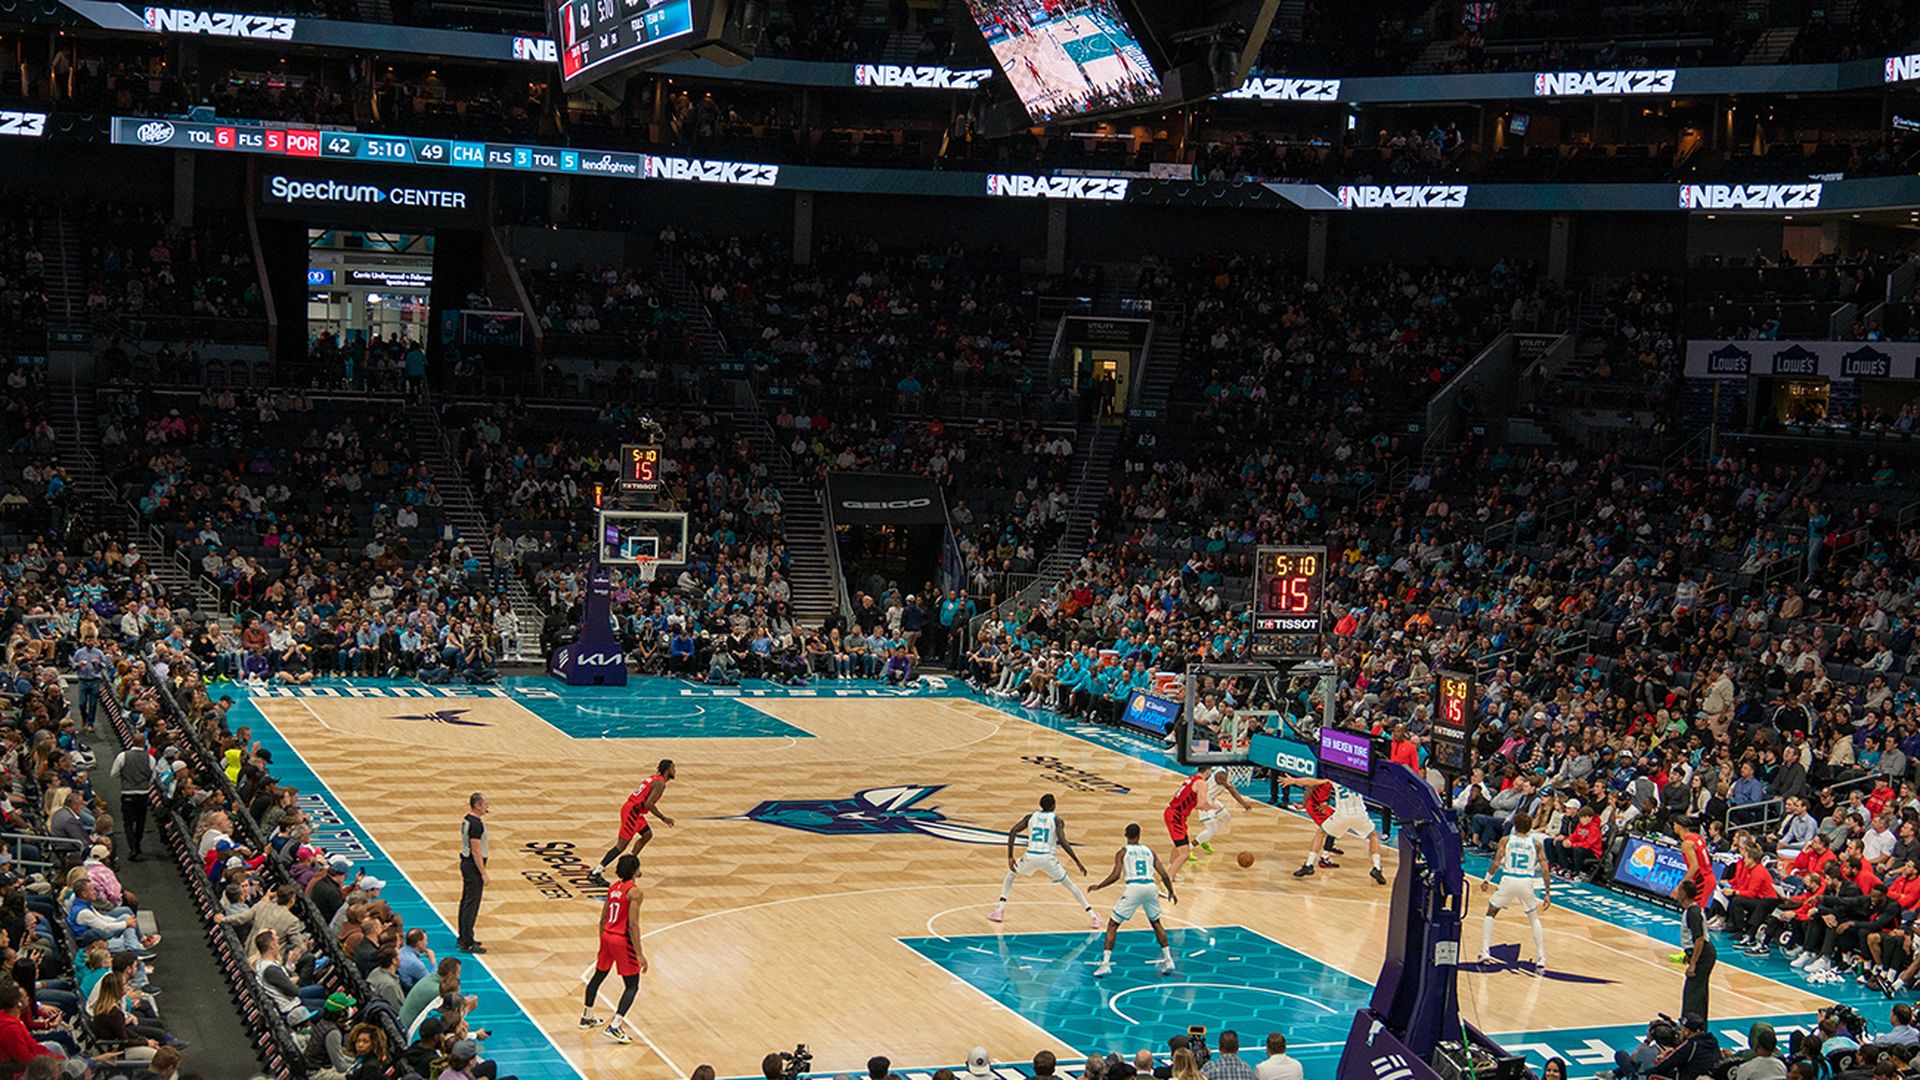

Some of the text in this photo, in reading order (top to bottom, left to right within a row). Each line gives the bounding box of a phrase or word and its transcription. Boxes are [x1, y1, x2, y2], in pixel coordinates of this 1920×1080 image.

[154, 8, 296, 40] NBA2K23
[1222, 78, 1341, 101] A2K23
[1544, 70, 1676, 96] NBA2K23
[188, 130, 229, 144] TOL 6
[238, 134, 278, 148] FLS 5
[286, 135, 318, 151] POR
[328, 138, 350, 153] 42
[367, 141, 406, 158] 5:10
[421, 145, 443, 160] 49
[453, 145, 484, 162] CHA
[489, 151, 527, 164] FLS 3
[533, 154, 575, 168] TOL 5
[650, 156, 780, 186] NBA2K23
[271, 176, 466, 208] Spectrum CENTER
[997, 174, 1128, 200] NBA2K23
[1345, 185, 1468, 209] NBA2K23
[1689, 184, 1821, 209] NBA2K23
[1712, 355, 1748, 372] LOWE'S
[1776, 356, 1814, 373] LOWE'S
[1845, 357, 1887, 375] LOWE'S
[633, 449, 657, 461] 5:10
[635, 462, 653, 481] 15
[633, 482, 659, 491] TISSOT
[842, 498, 931, 510] GEICO
[1276, 555, 1316, 576] 5:10
[1279, 577, 1310, 613] 15
[1275, 618, 1319, 631] TISSOT
[249, 686, 560, 699] HORNETS
[1449, 698, 1461, 721] 15
[1276, 752, 1314, 776] GEICO
[1031, 827, 1049, 843] 21
[1135, 860, 1147, 877] 9
[1511, 852, 1530, 869] 12
[608, 902, 621, 924] 17
